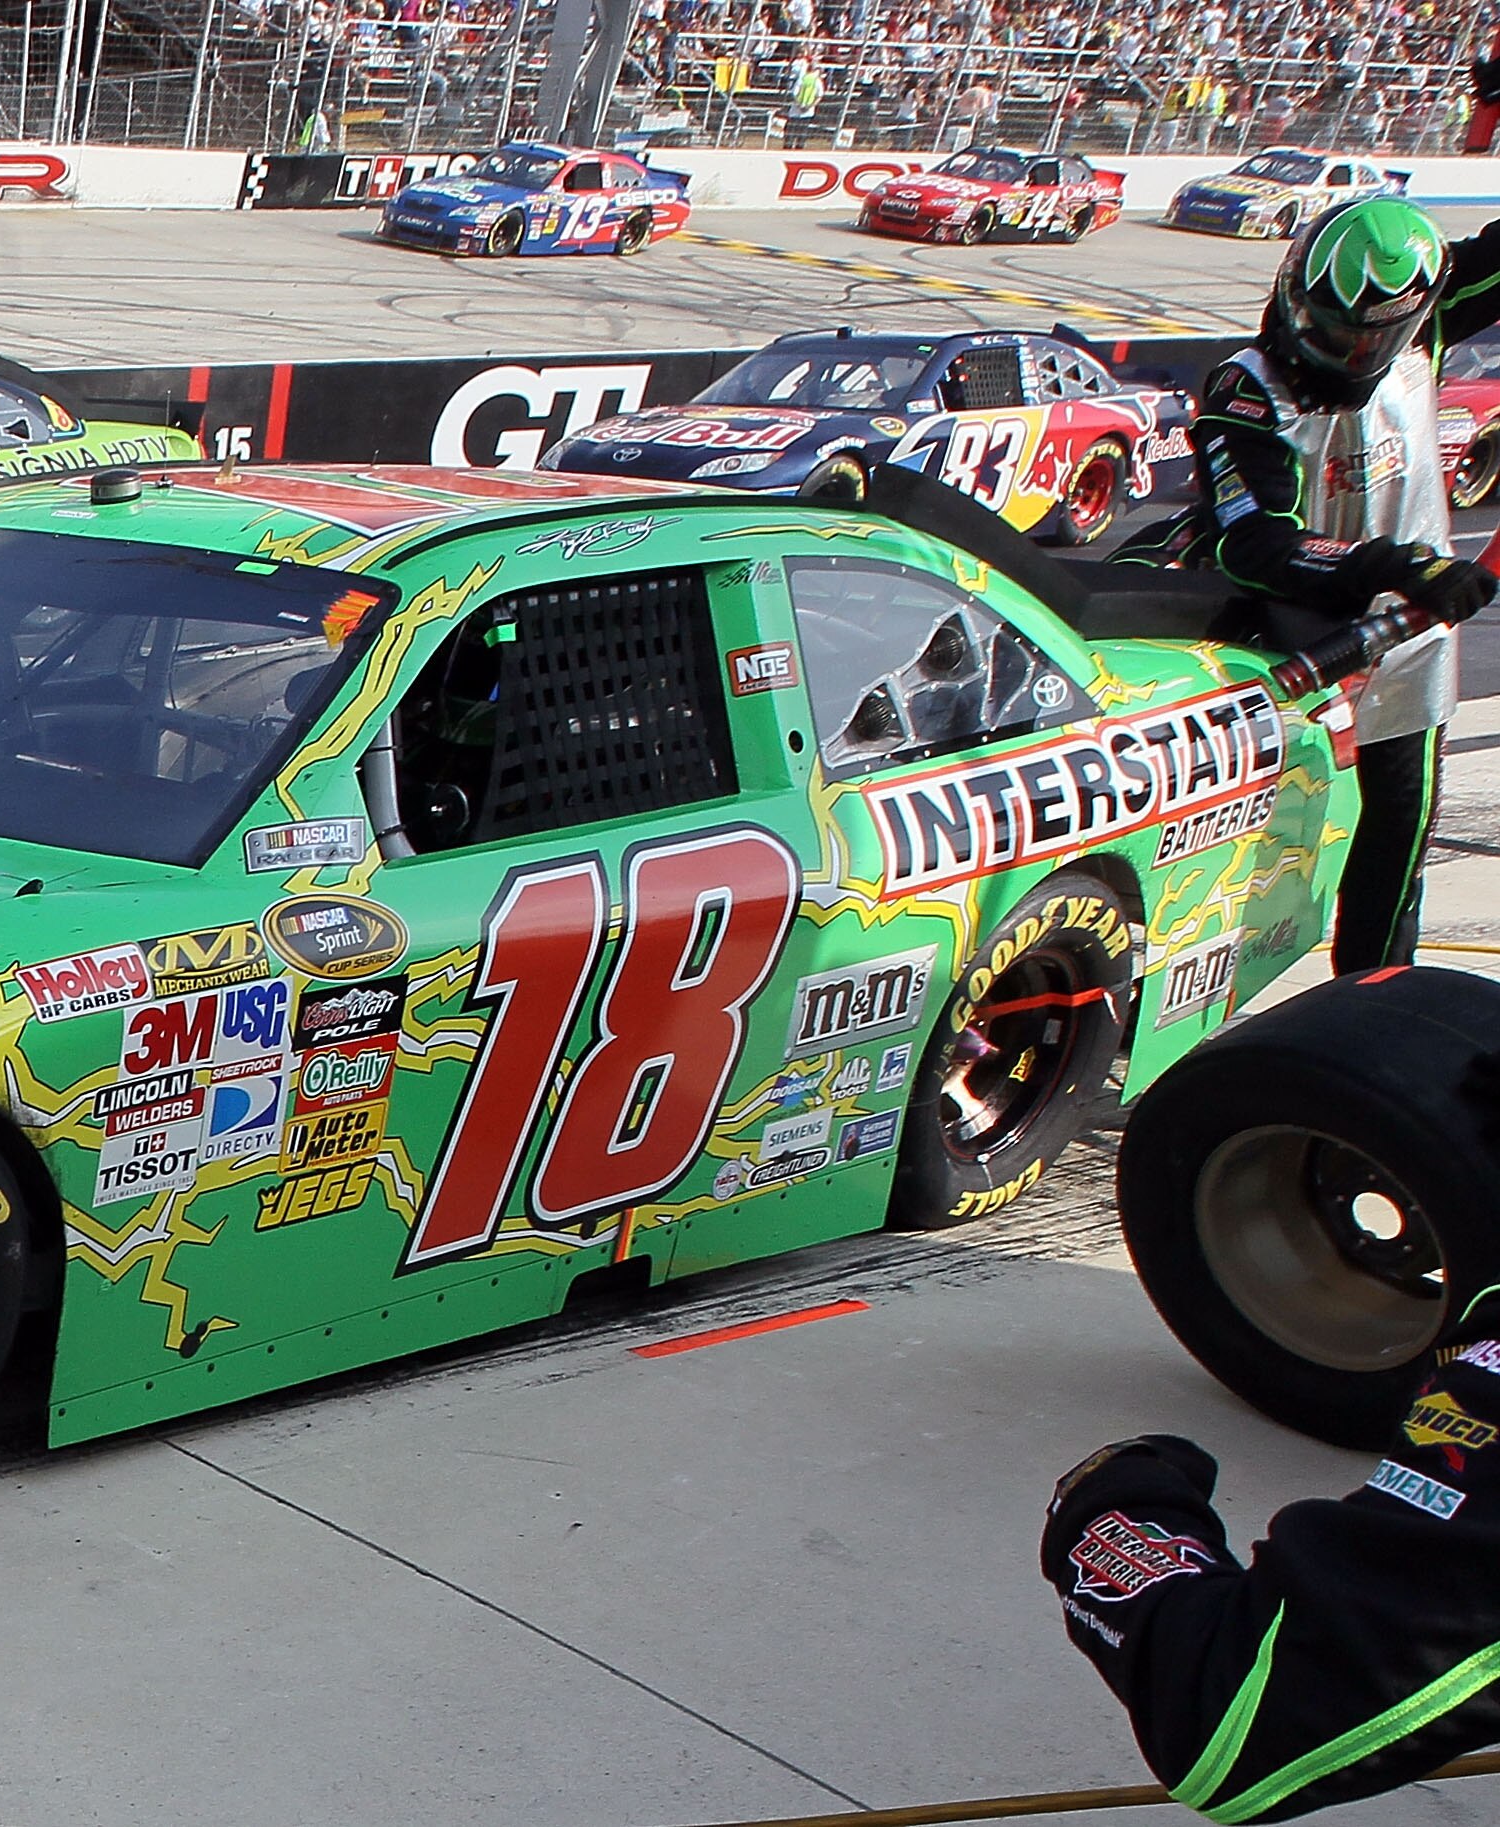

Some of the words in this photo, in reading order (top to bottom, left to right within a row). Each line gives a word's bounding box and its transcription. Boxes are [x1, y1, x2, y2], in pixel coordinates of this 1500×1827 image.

[615, 189, 678, 207] GEICO
[1018, 190, 1059, 231] 14
[559, 196, 610, 240] 13
[430, 364, 652, 470] GT
[102, 436, 169, 466] HDTV
[214, 428, 253, 461] 15
[940, 415, 1030, 512] 83
[735, 648, 791, 684] NOS
[875, 688, 1283, 888] INTERSTATE
[292, 824, 347, 846] NASCAR
[1154, 785, 1280, 863] BATTERIES
[256, 850, 313, 866] RACE
[316, 847, 357, 862] CAR
[301, 906, 350, 932] NASCAR
[315, 924, 364, 956] Sprint
[20, 953, 149, 1005] Holley
[326, 960, 352, 975] CUP
[353, 950, 395, 970] SERIES
[38, 1001, 65, 1019] HP
[69, 988, 132, 1013] CARBS
[222, 981, 288, 1049] USG
[302, 1002, 349, 1030] Coors
[348, 995, 399, 1021] LIGHT
[123, 994, 219, 1075] 3M
[312, 1018, 382, 1042] POLE
[400, 826, 800, 1270] 18
[211, 1056, 281, 1081] SHEETROCK
[304, 1050, 391, 1097] O'Reilly
[831, 1056, 872, 1091] MAC
[98, 1073, 190, 1114] LINCOLN
[770, 1076, 823, 1101] DOOSAN
[830, 1082, 870, 1101] TOOLS
[114, 1099, 194, 1132] WELDERS
[311, 1110, 369, 1140] Auto
[204, 1131, 276, 1160] DIRECTV
[307, 1128, 378, 1161] Meter
[768, 1120, 824, 1147] SIEMENS
[99, 1148, 198, 1190] TISSOT
[752, 1151, 826, 1184] FREIGHTLINER
[118, 1185, 152, 1199] WATCHES
[254, 1164, 378, 1231] JEGS
[947, 1157, 1044, 1218] EAGLE
[1410, 1402, 1494, 1446] NOCO
[1371, 1462, 1460, 1515] EMENS
[1092, 1517, 1183, 1575] INTERSTATE
[1077, 1540, 1150, 1592] BATTERIES
